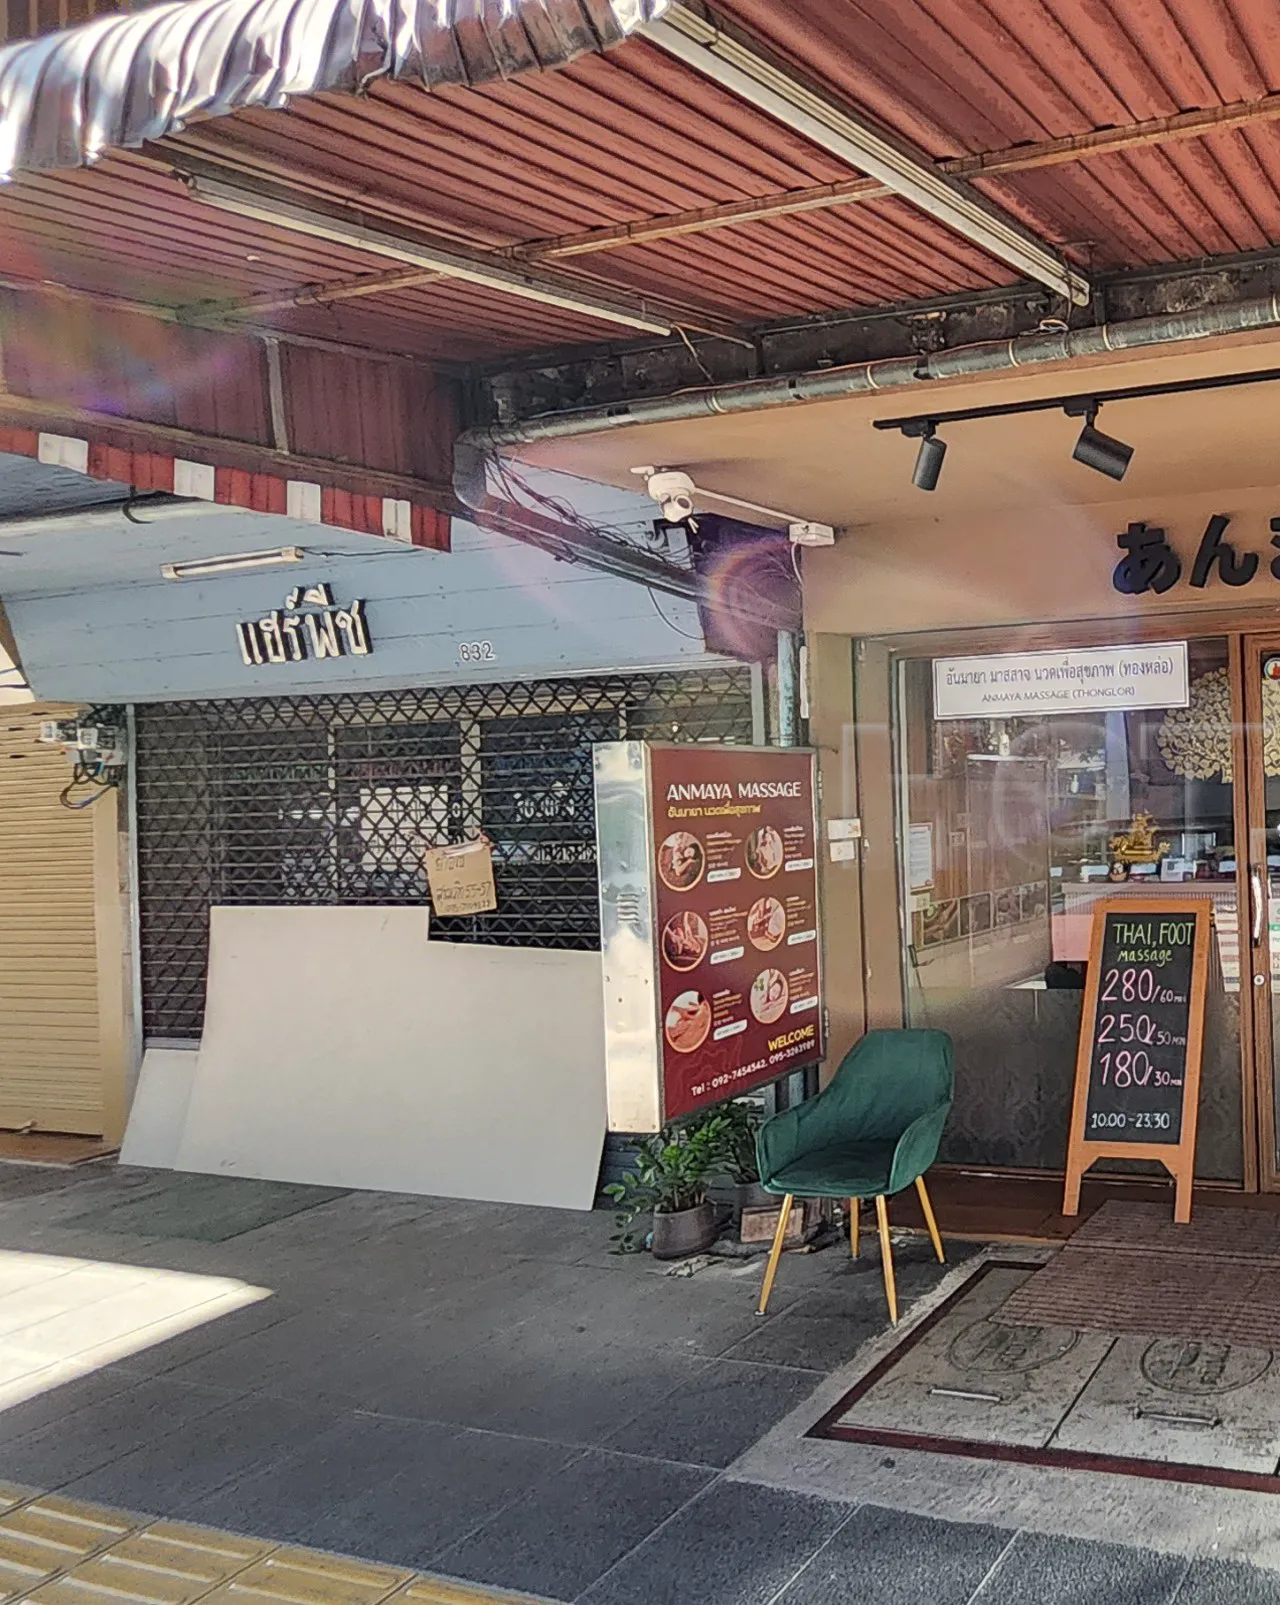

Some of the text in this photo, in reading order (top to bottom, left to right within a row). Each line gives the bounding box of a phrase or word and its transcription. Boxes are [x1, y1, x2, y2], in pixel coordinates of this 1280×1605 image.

[459, 641, 495, 662] 832
[946, 655, 1174, 685] อันมายา มาสสาจ นวดเพื่อสุขภาพ (ทองหล่อ)
[982, 686, 1136, 702] ANMAYA MASSAGE (THONGLOR)
[667, 781, 802, 801] ANMAYA MASSAGE
[1159, 922, 1195, 946] FOOT
[768, 1024, 815, 1052] WELCOME
